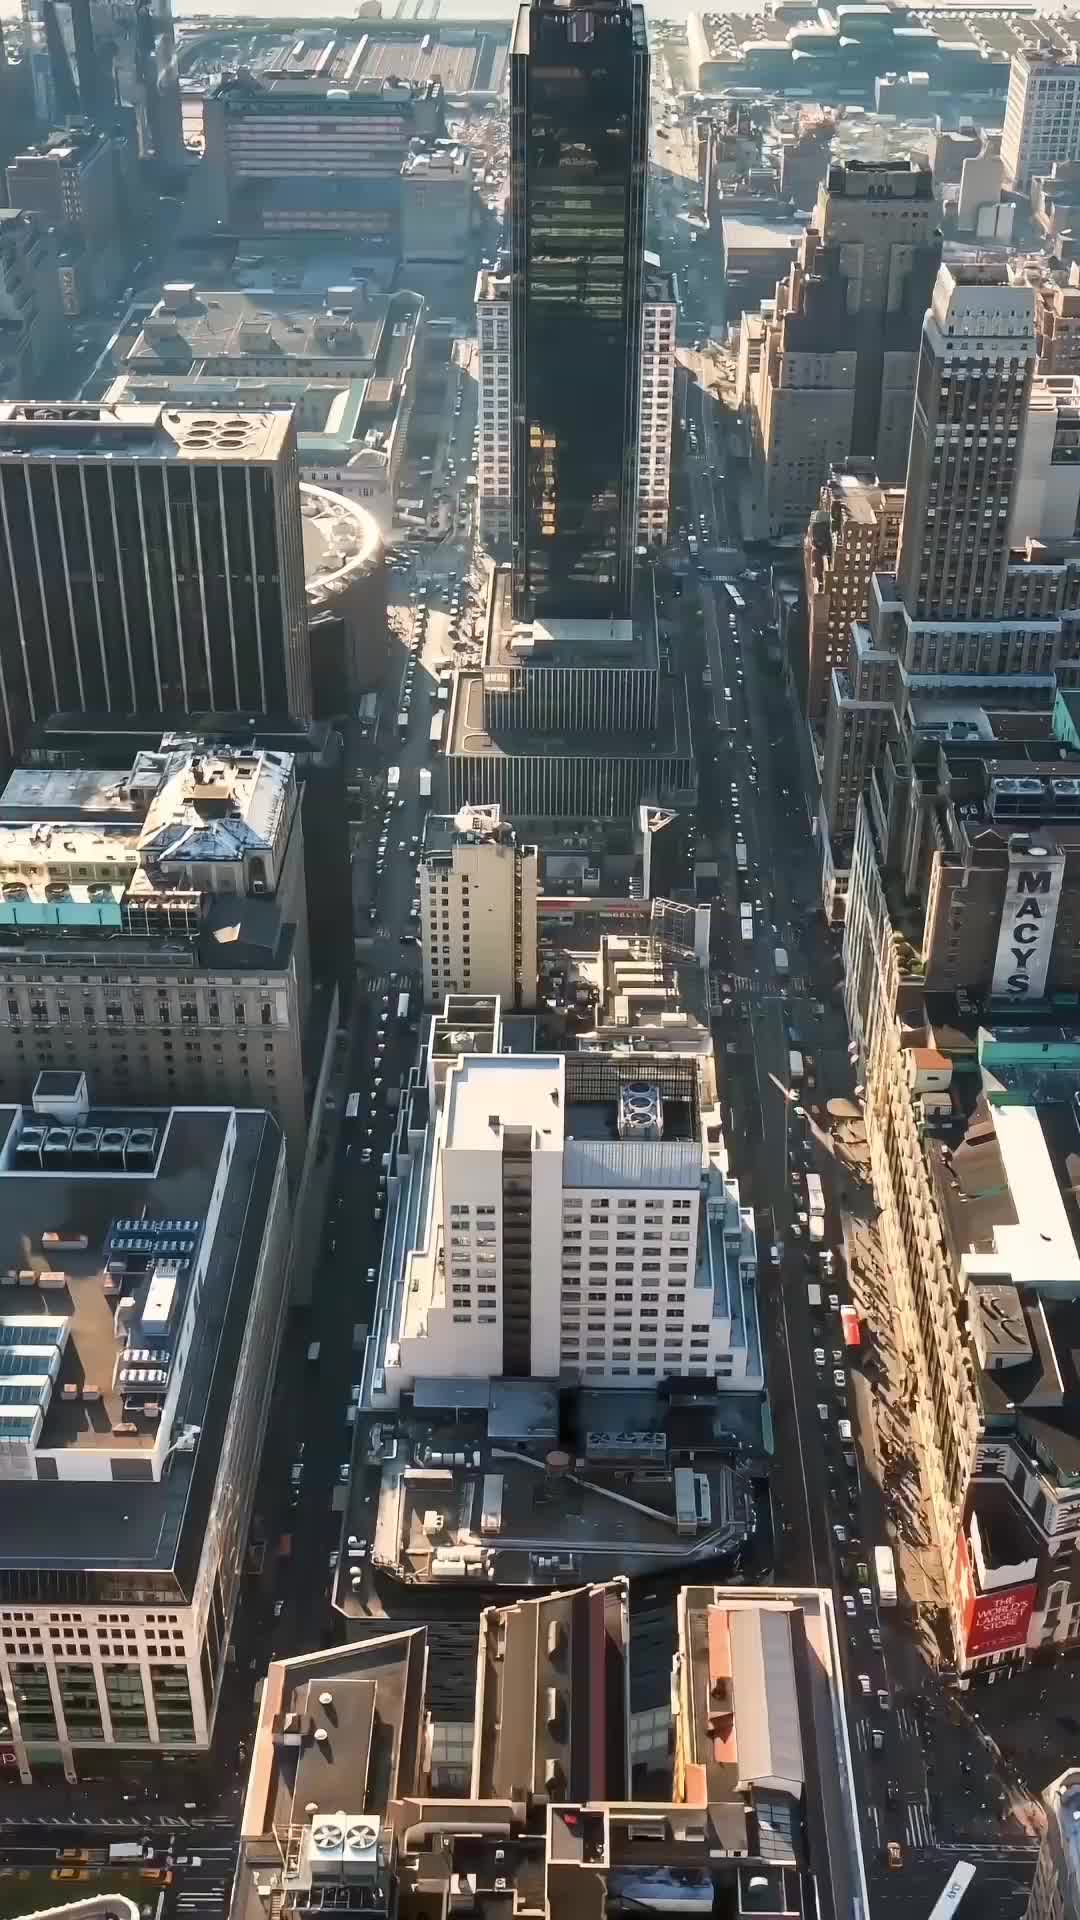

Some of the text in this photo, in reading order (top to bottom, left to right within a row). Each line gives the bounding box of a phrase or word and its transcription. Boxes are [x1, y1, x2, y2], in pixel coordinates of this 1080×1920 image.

[994, 1595, 1016, 1607] THE
[977, 1600, 1029, 1619] WORLD'S
[975, 1609, 1025, 1627] LARGEST
[983, 1616, 1017, 1631] STORE
